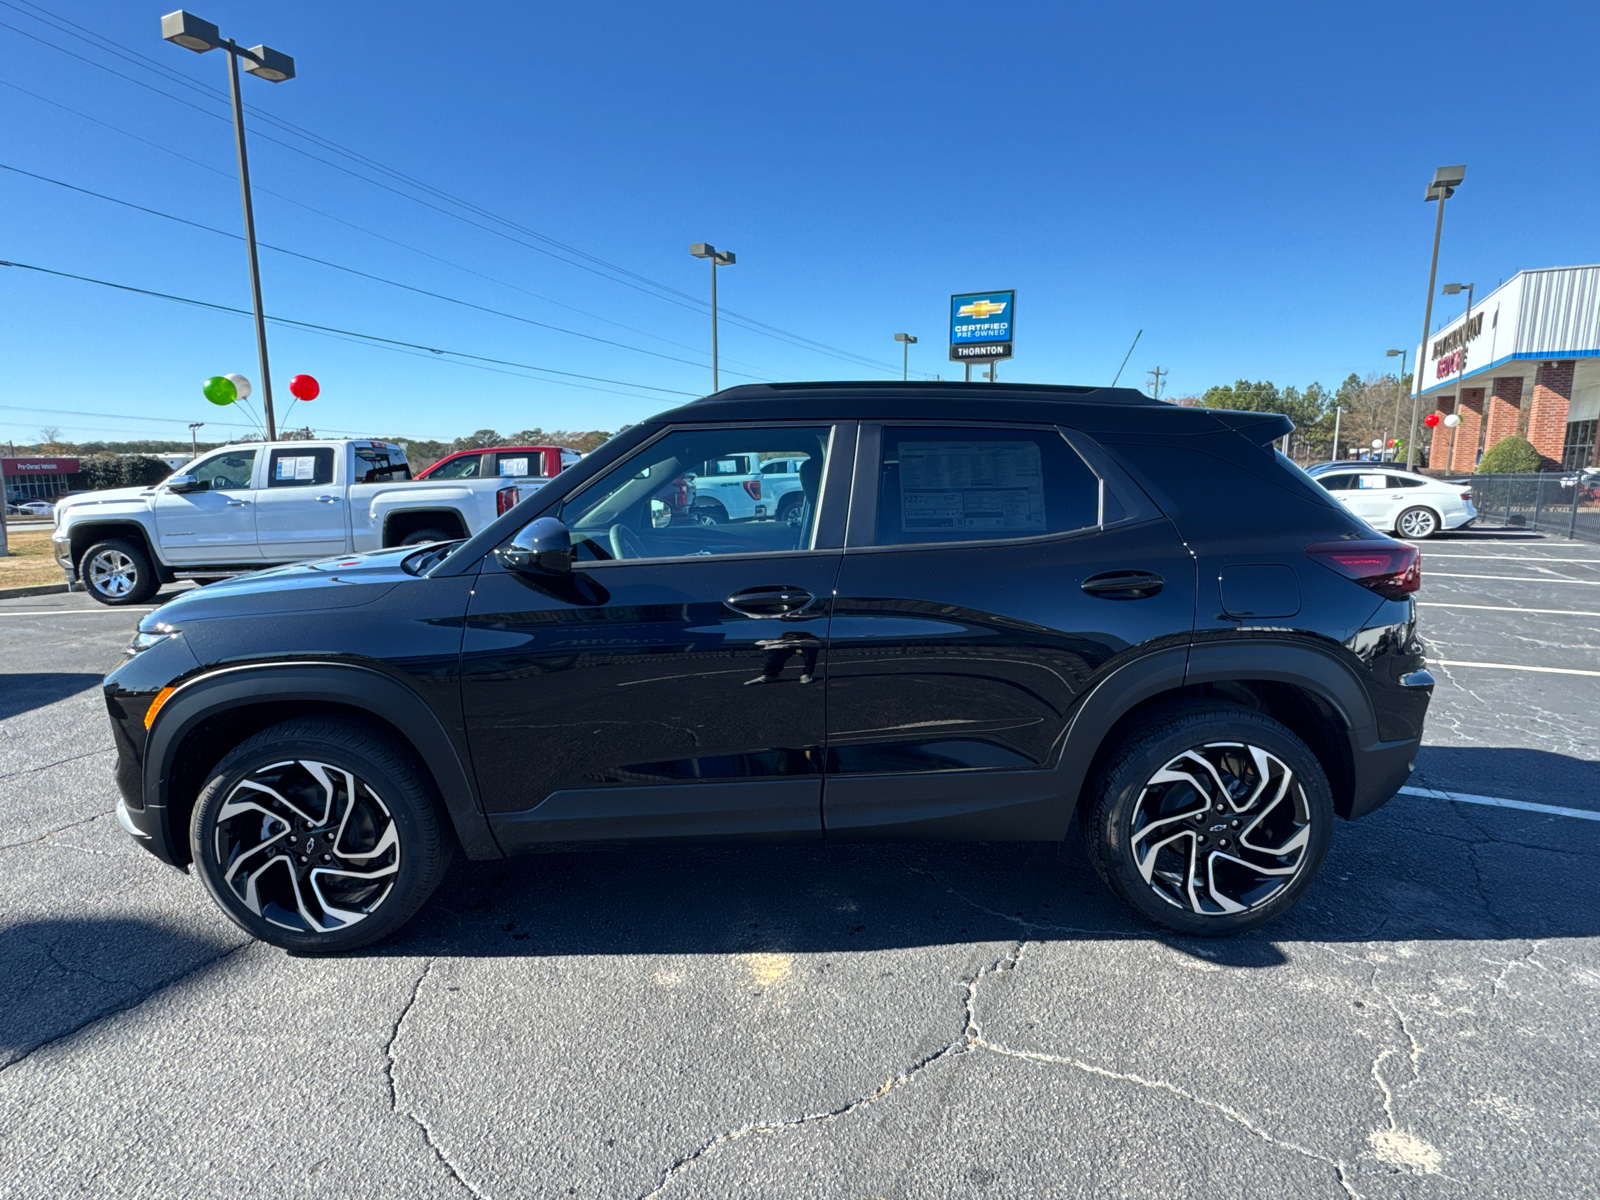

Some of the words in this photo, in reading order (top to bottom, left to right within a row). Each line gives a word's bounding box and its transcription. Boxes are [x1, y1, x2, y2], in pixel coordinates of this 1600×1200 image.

[954, 322, 1008, 332] CERTIFIED
[957, 329, 1005, 338] PRE-OWNED
[957, 346, 1003, 356] THORNTON
[195, 790, 213, 840] Continental
